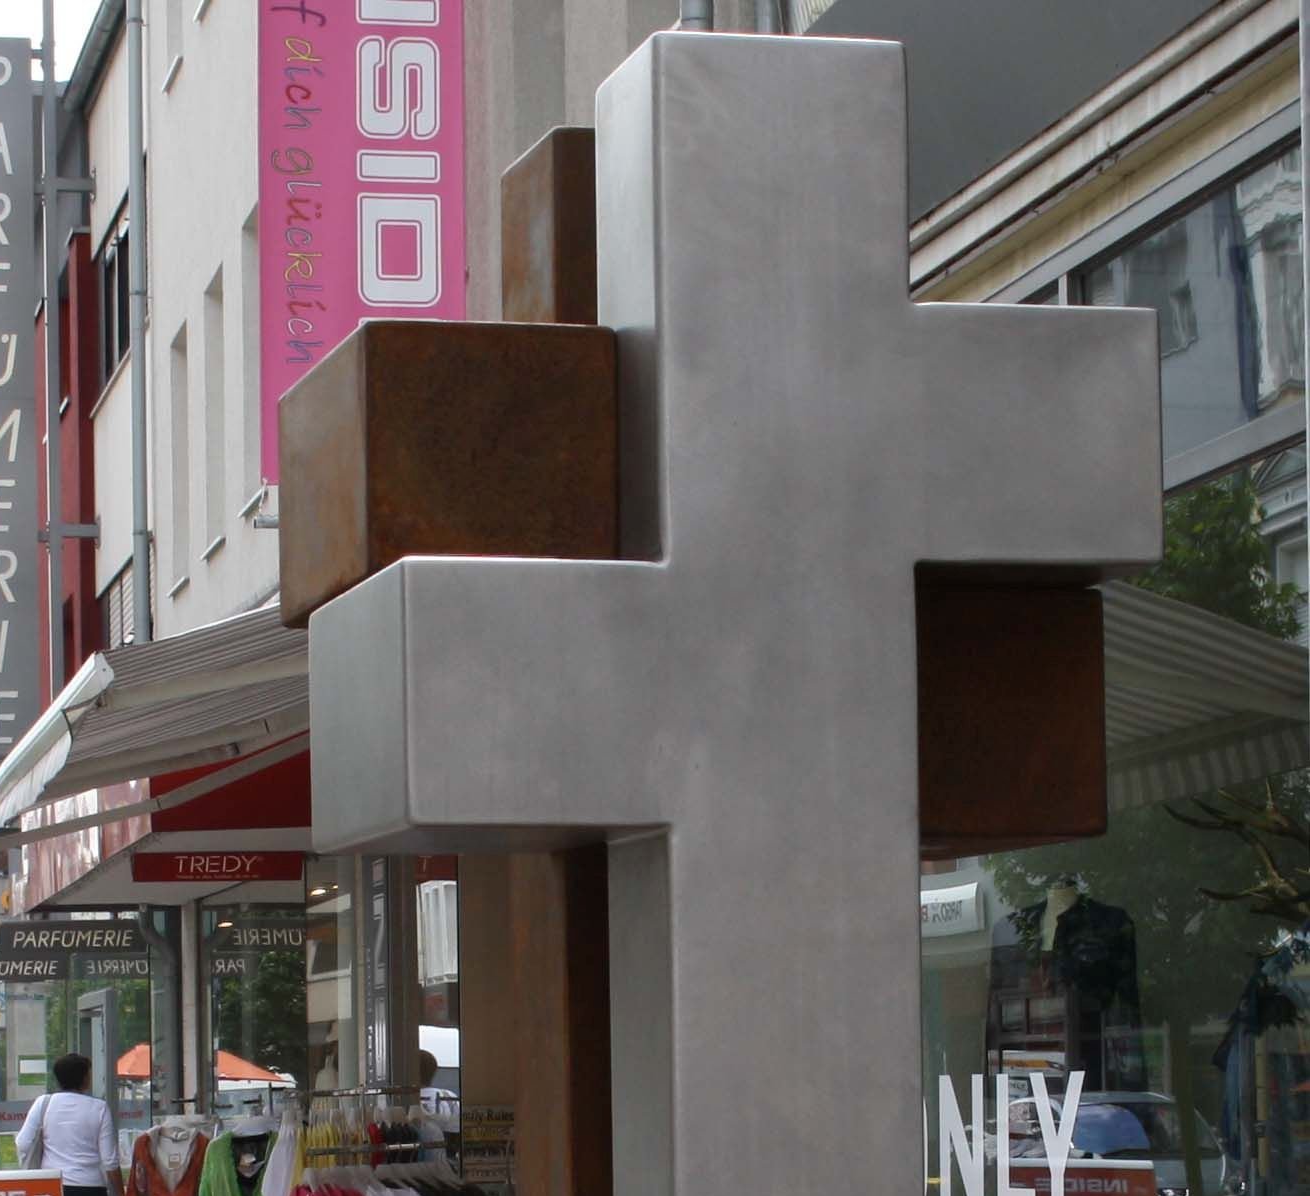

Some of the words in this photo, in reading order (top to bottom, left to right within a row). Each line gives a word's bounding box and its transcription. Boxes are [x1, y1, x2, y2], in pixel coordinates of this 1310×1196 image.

[284, 36, 325, 129] dich
[270, 147, 327, 364] glücklich
[175, 856, 258, 873] TREDY
[13, 929, 134, 948] PARFÜMERIE
